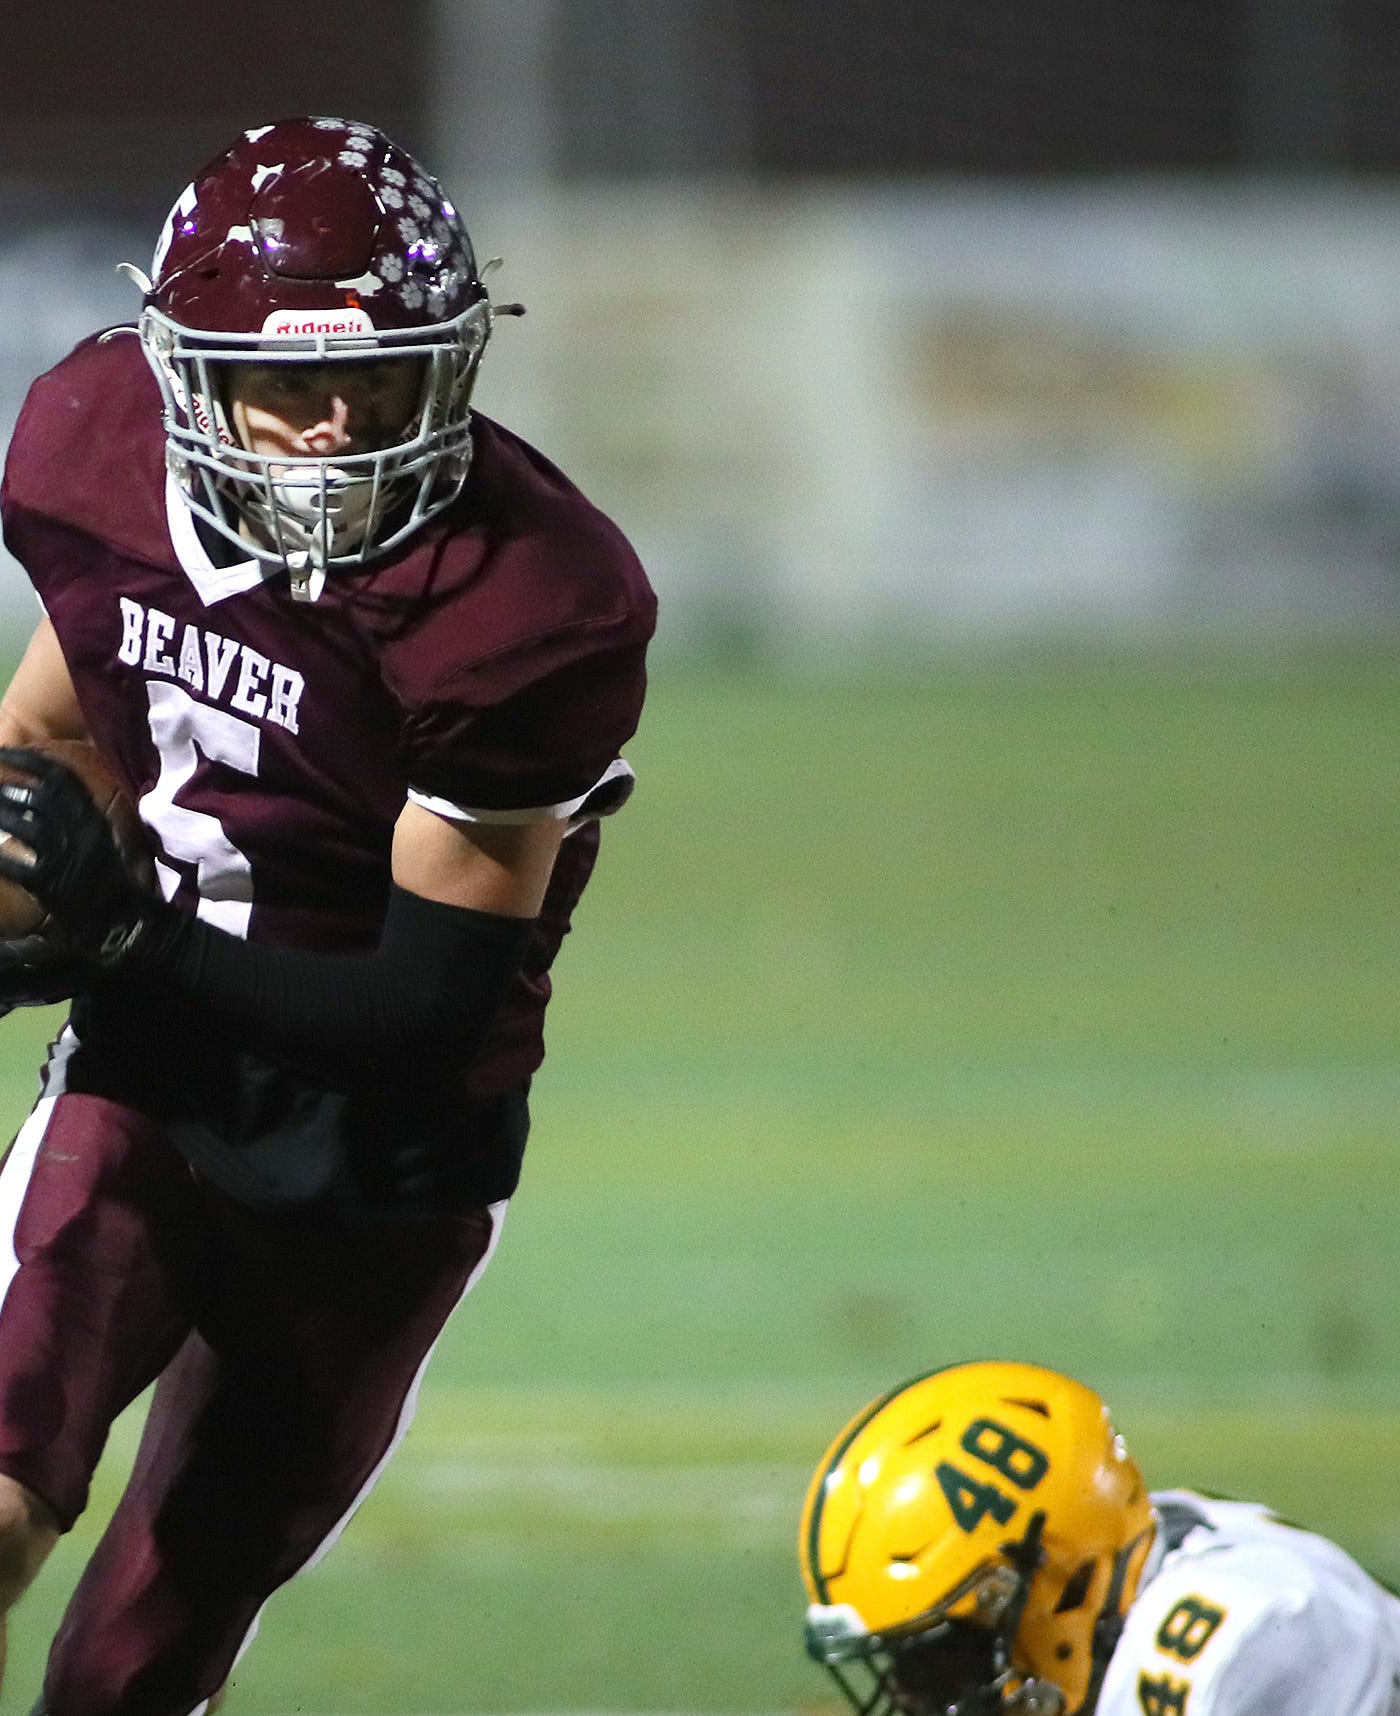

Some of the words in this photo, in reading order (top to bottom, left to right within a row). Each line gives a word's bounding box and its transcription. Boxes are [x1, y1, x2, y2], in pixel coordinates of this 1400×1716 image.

[118, 597, 305, 735] BEAVER
[138, 680, 261, 940] 5
[934, 1417, 1049, 1533] 48
[1135, 1591, 1229, 1716] 48
